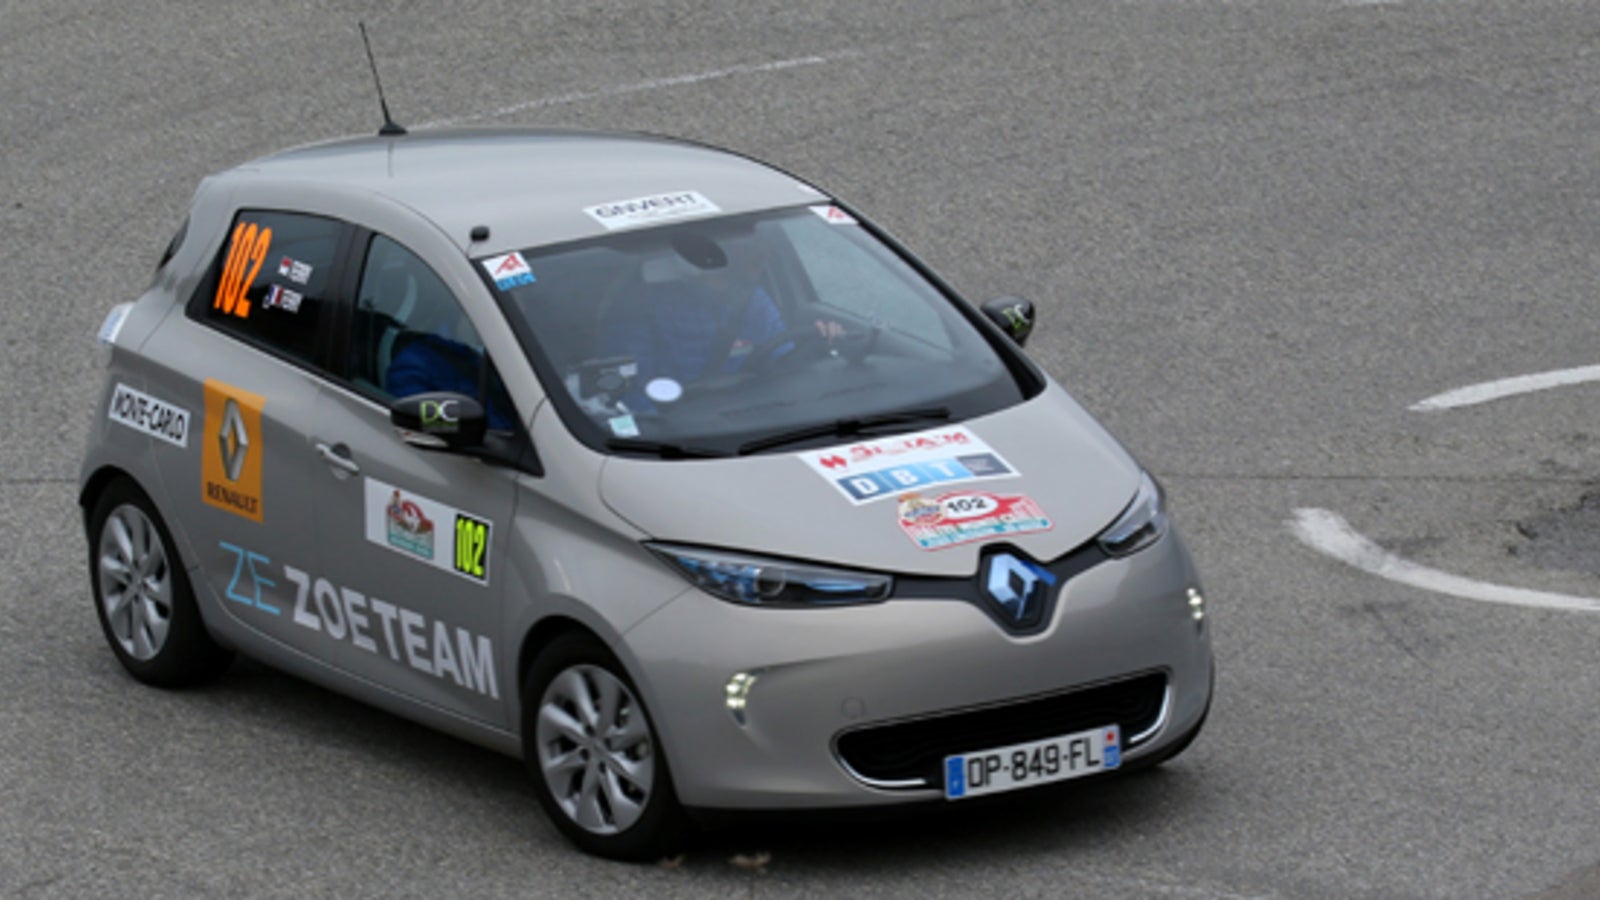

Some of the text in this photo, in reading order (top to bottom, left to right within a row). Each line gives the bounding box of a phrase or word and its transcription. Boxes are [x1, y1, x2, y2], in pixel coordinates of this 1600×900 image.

[213, 221, 273, 319] 102
[113, 389, 186, 440] MONTE-CARLO
[420, 399, 459, 425] DC
[207, 480, 258, 514] RENAULT
[947, 498, 987, 513] 102
[456, 518, 488, 576] 102
[967, 737, 1099, 788] DP-849-FL
